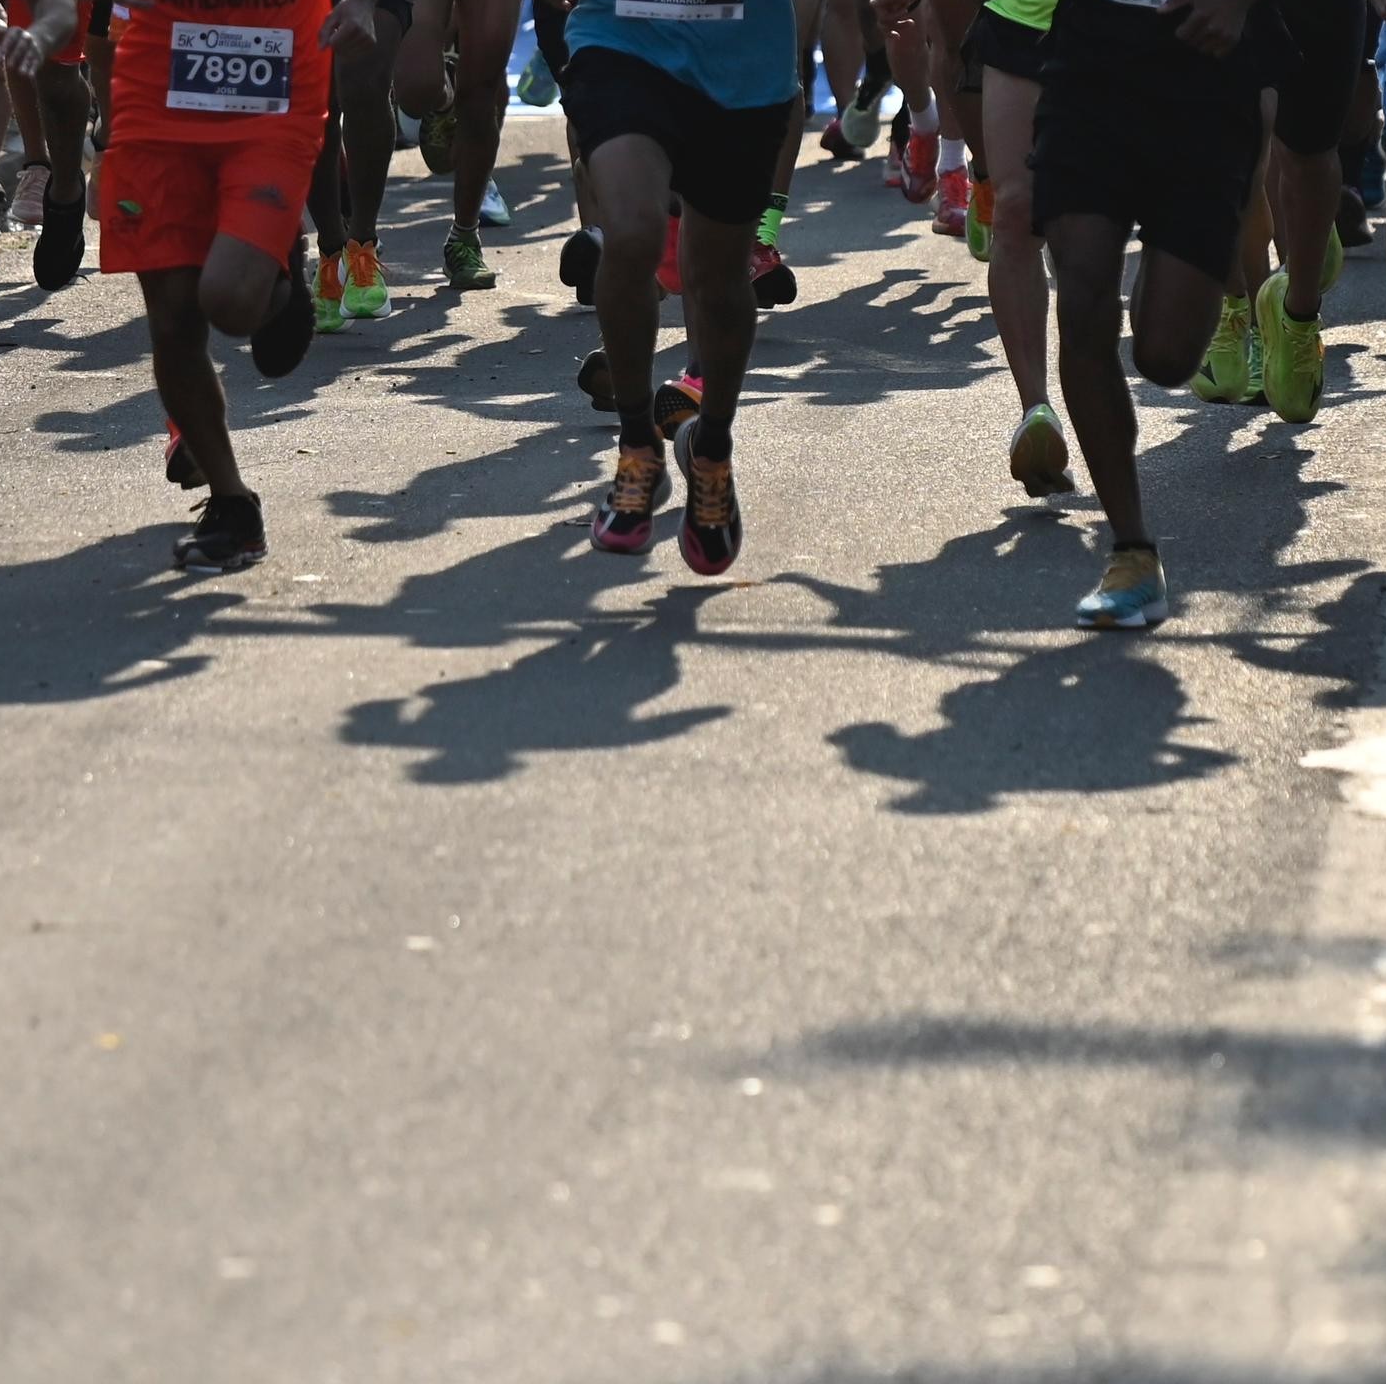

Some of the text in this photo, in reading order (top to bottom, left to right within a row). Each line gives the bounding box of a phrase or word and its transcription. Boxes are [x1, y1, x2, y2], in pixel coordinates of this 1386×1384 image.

[177, 34, 195, 47] 5K
[264, 40, 283, 53] 5K
[186, 54, 273, 85] 7890
